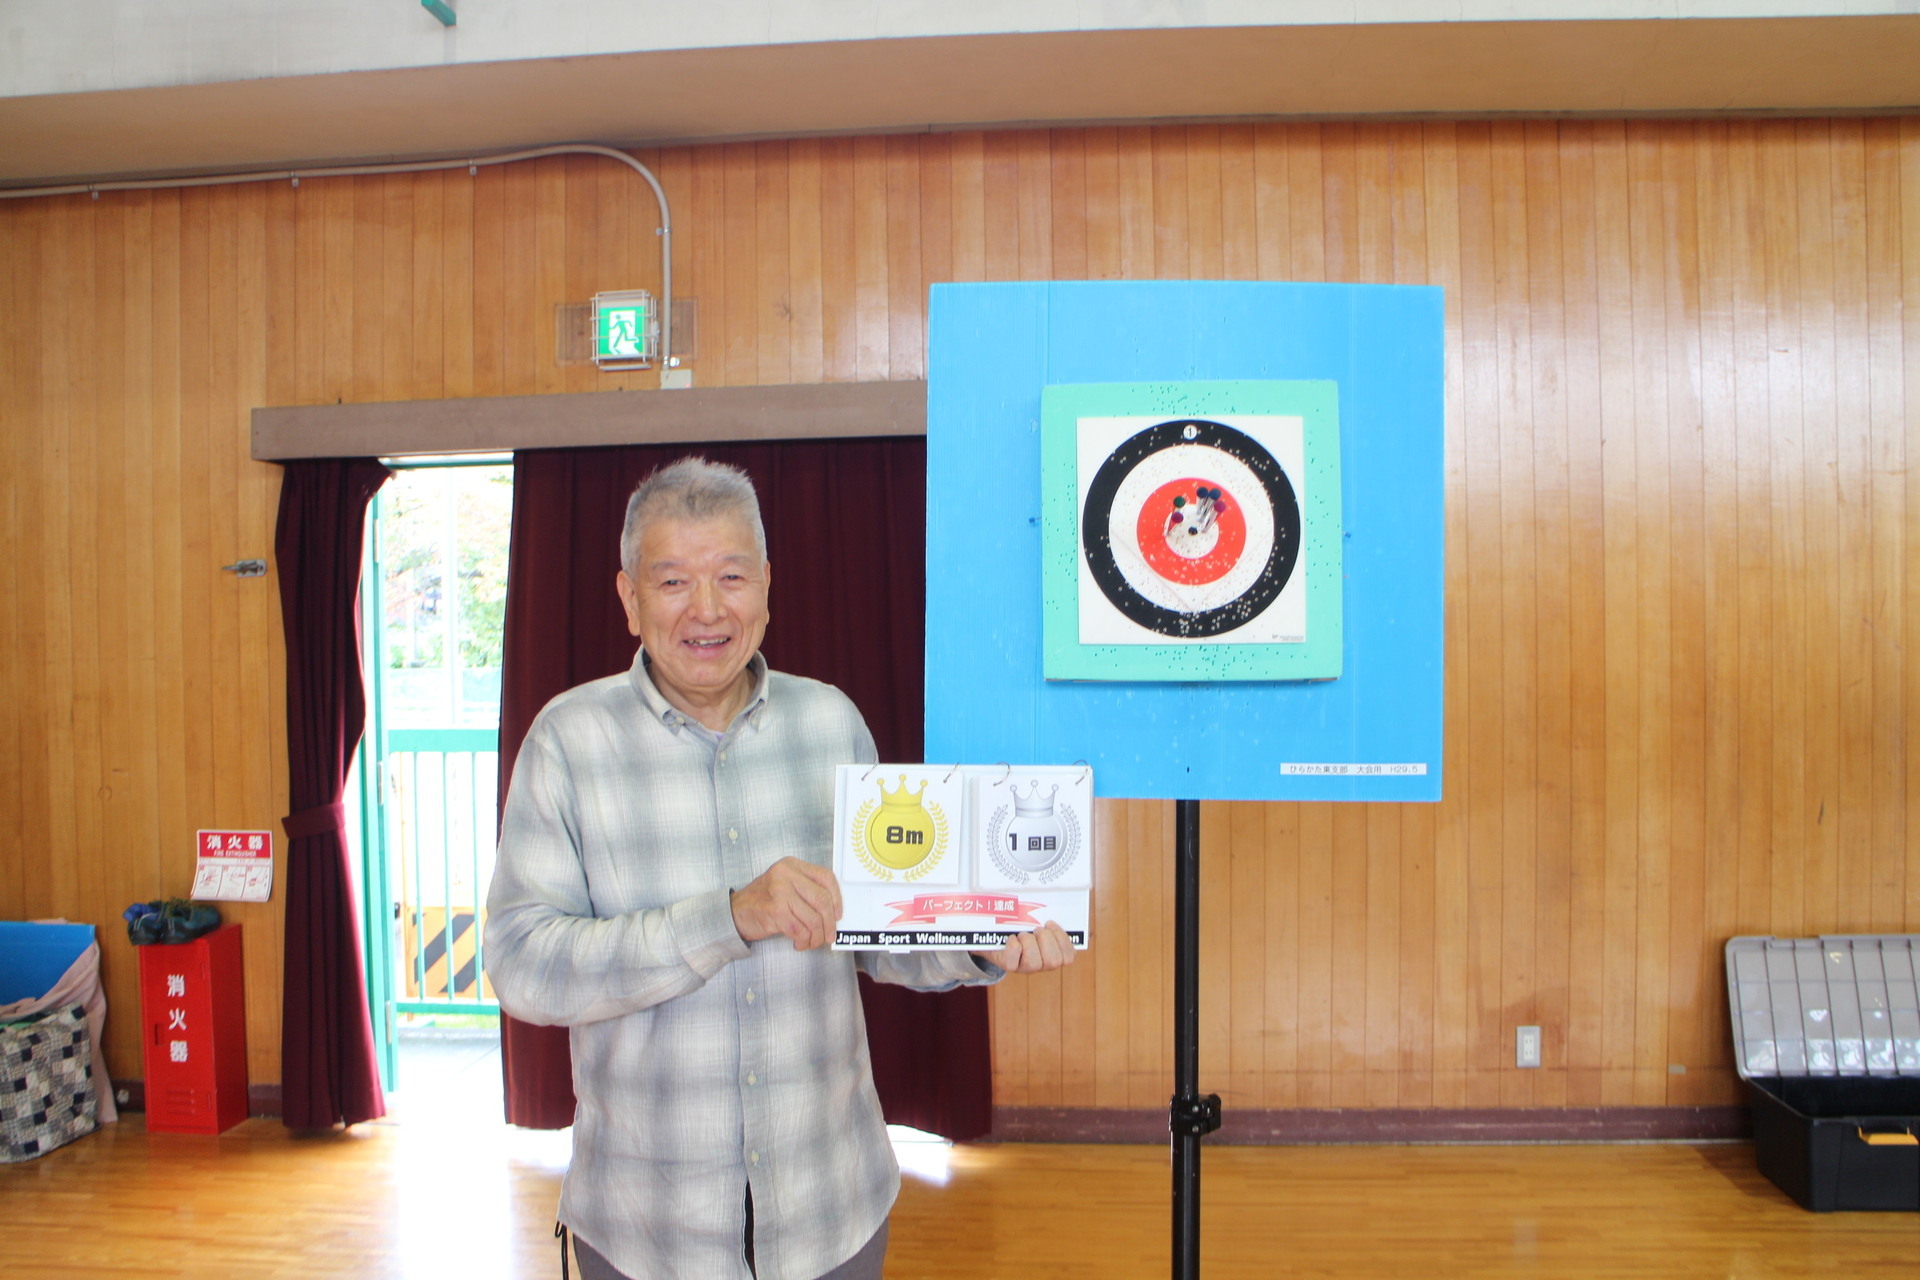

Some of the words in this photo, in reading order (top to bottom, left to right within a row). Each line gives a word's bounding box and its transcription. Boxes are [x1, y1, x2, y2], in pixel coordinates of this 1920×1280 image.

[1290, 765, 1349, 774] ひらかた東支部
[1356, 765, 1382, 774] 大会用
[1390, 766, 1418, 774] H29.5
[207, 834, 263, 850] 消火器
[886, 826, 923, 844] 8m
[837, 932, 871, 946] Japan
[878, 932, 910, 946] Sport
[916, 932, 967, 944] Wellness
[167, 974, 188, 1062] 消火器
